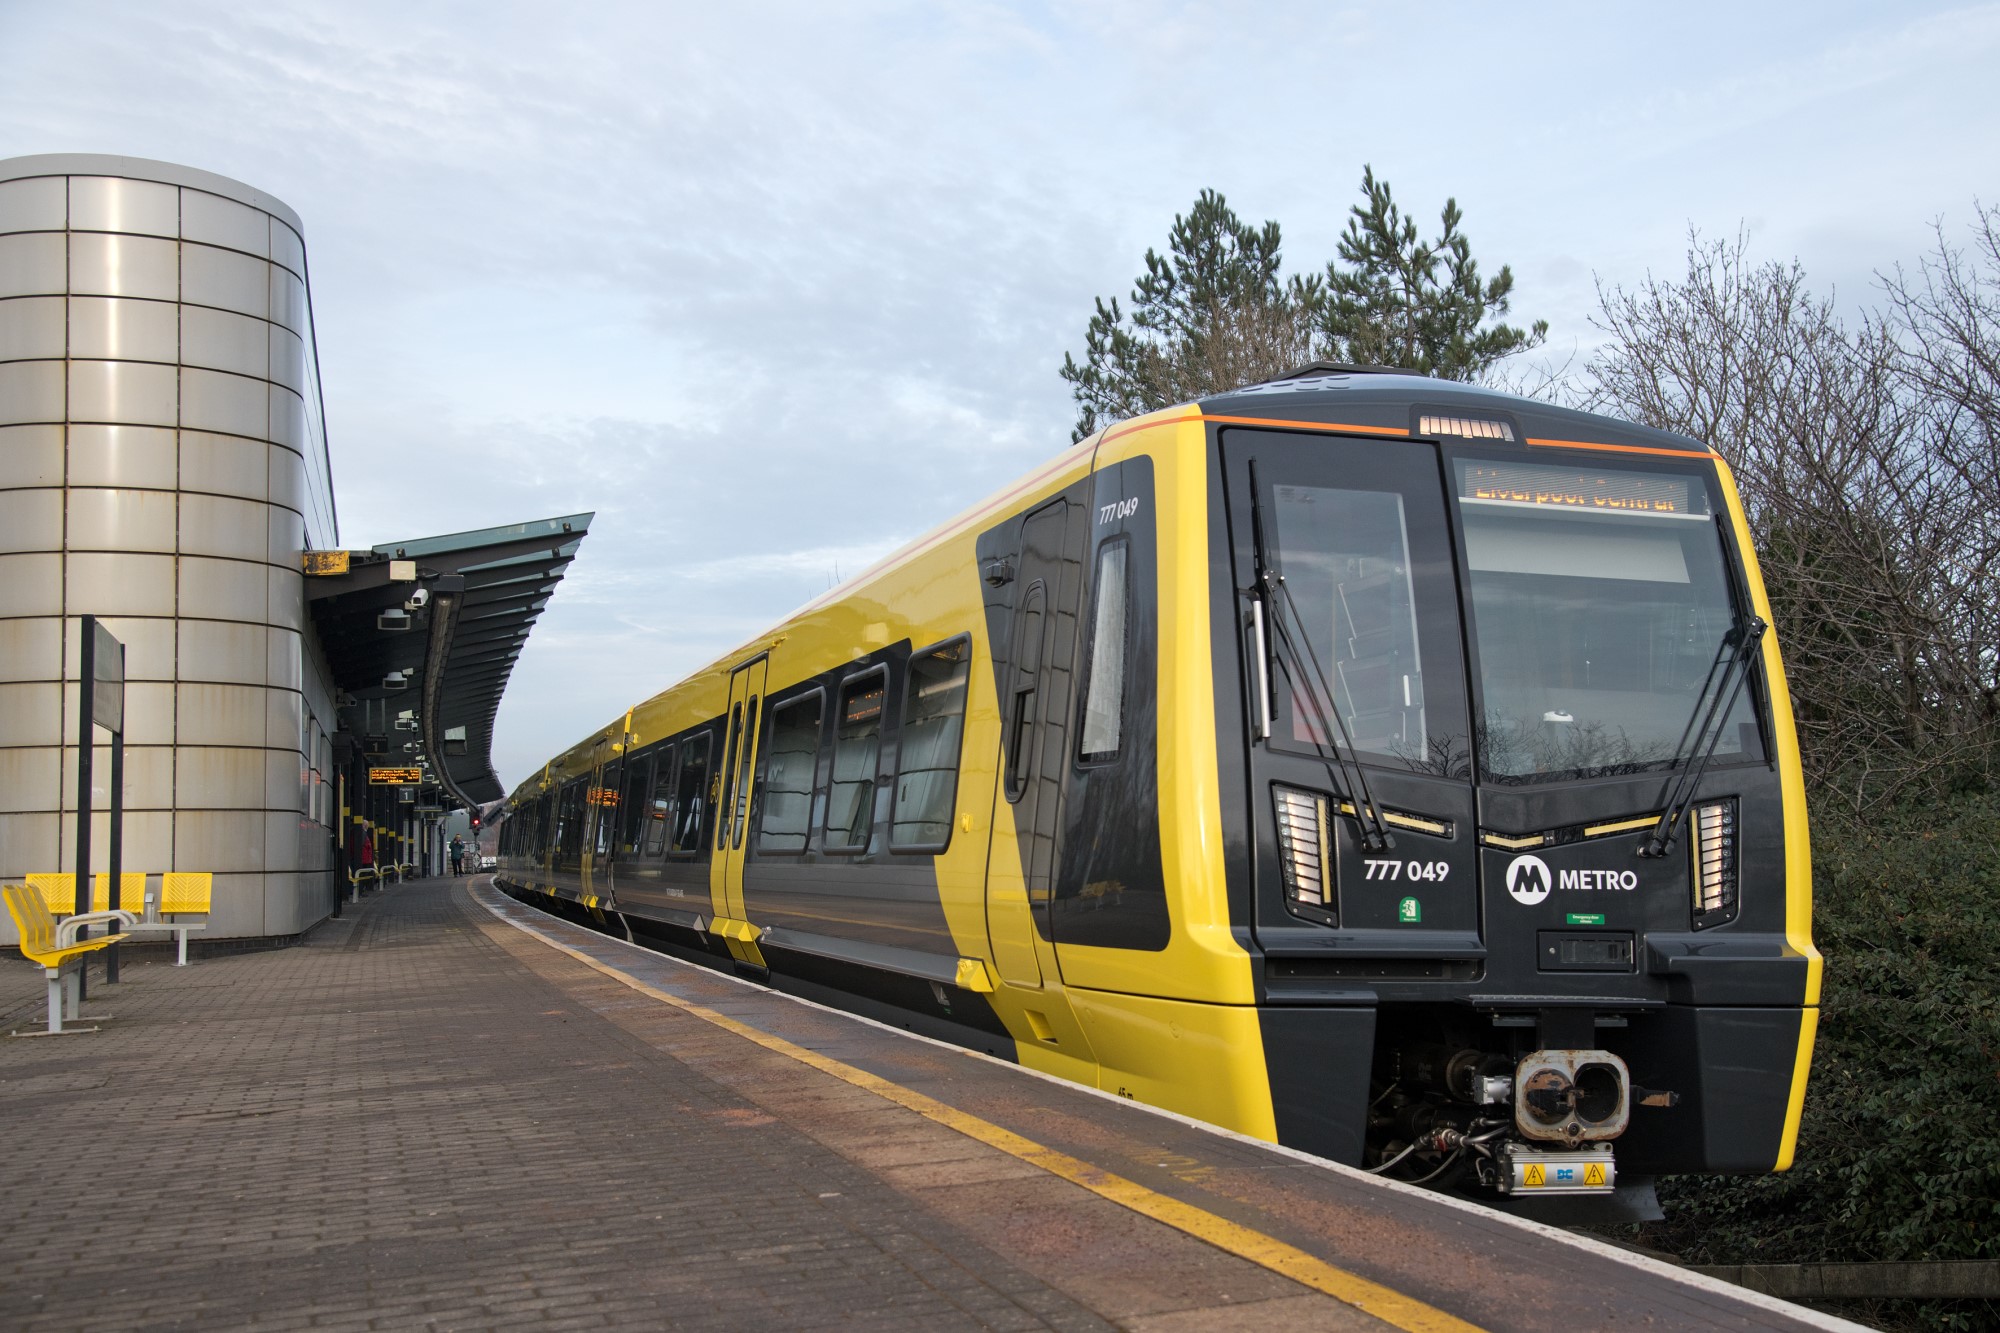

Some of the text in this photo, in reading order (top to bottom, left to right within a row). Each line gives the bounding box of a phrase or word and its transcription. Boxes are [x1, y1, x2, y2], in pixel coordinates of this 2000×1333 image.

[1099, 497, 1138, 525] 777 049
[404, 791, 409, 801] 1
[1364, 860, 1449, 881] 777 049
[1512, 864, 1638, 893] M METRO
